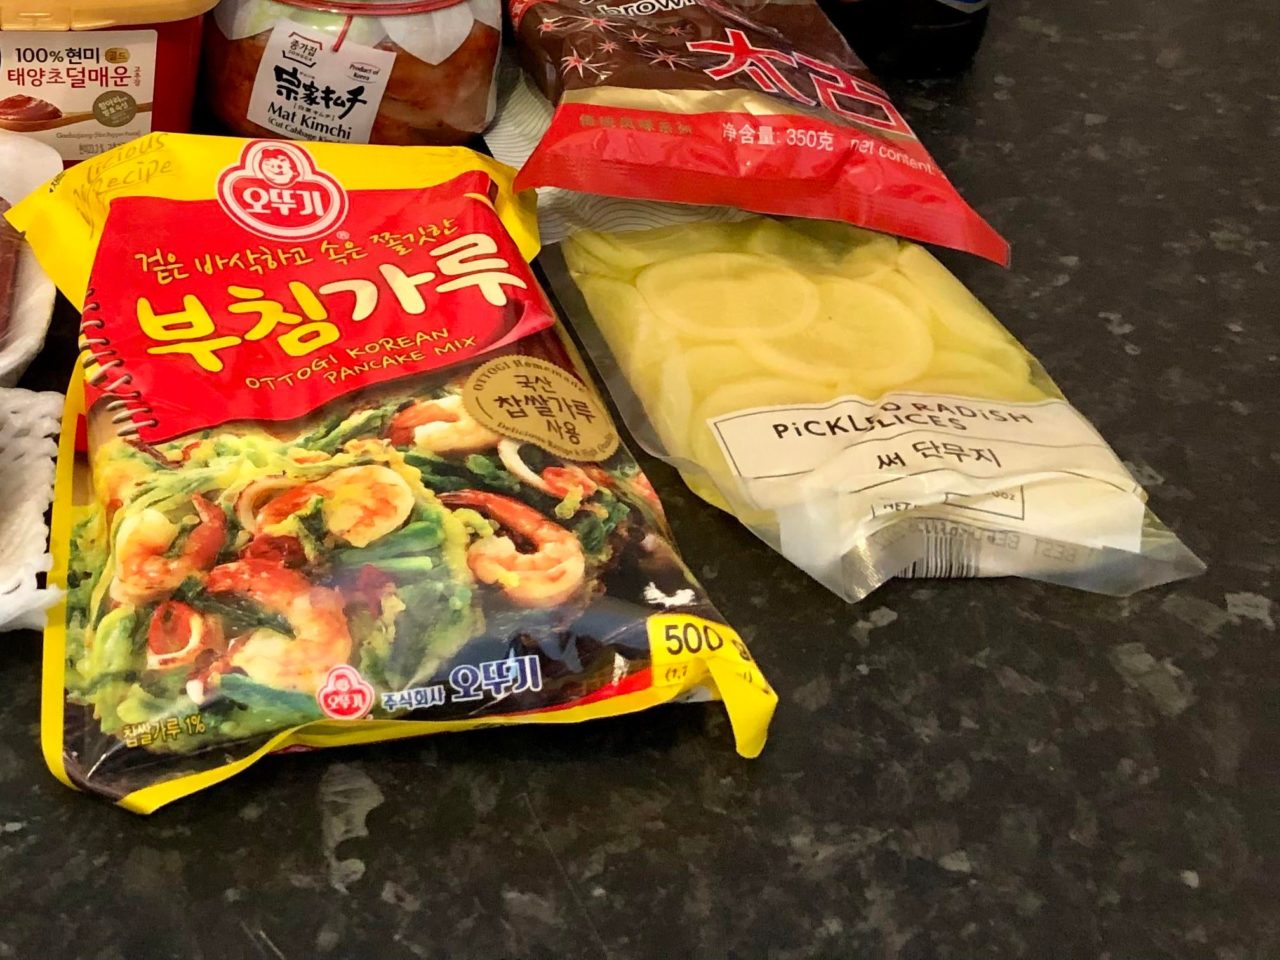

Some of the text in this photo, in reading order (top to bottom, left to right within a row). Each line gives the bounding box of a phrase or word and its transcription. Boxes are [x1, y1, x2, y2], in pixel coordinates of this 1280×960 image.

[290, 39, 318, 57] 종가집
[267, 101, 297, 123] Mat
[300, 114, 352, 140] Kimchi
[243, 186, 325, 217] 오뚜기
[195, 246, 314, 278] 바삭하고
[320, 239, 369, 266] 속은
[369, 216, 459, 257] 쫄깃한
[136, 232, 528, 372] 부침가루
[245, 327, 450, 391] OTTOGI KOREAN
[323, 335, 477, 384] PANCAKE MIX
[472, 362, 511, 392] OTTOGI
[514, 374, 556, 394] 국산
[494, 394, 597, 424] 찹쌀가루
[870, 413, 967, 432] LICES
[546, 419, 581, 446] 사용
[912, 439, 1002, 468] 단무지
[327, 654, 543, 712] 오뚜기 주식회사 오뚜기
[122, 715, 206, 748] 찹쌀가루 1%
